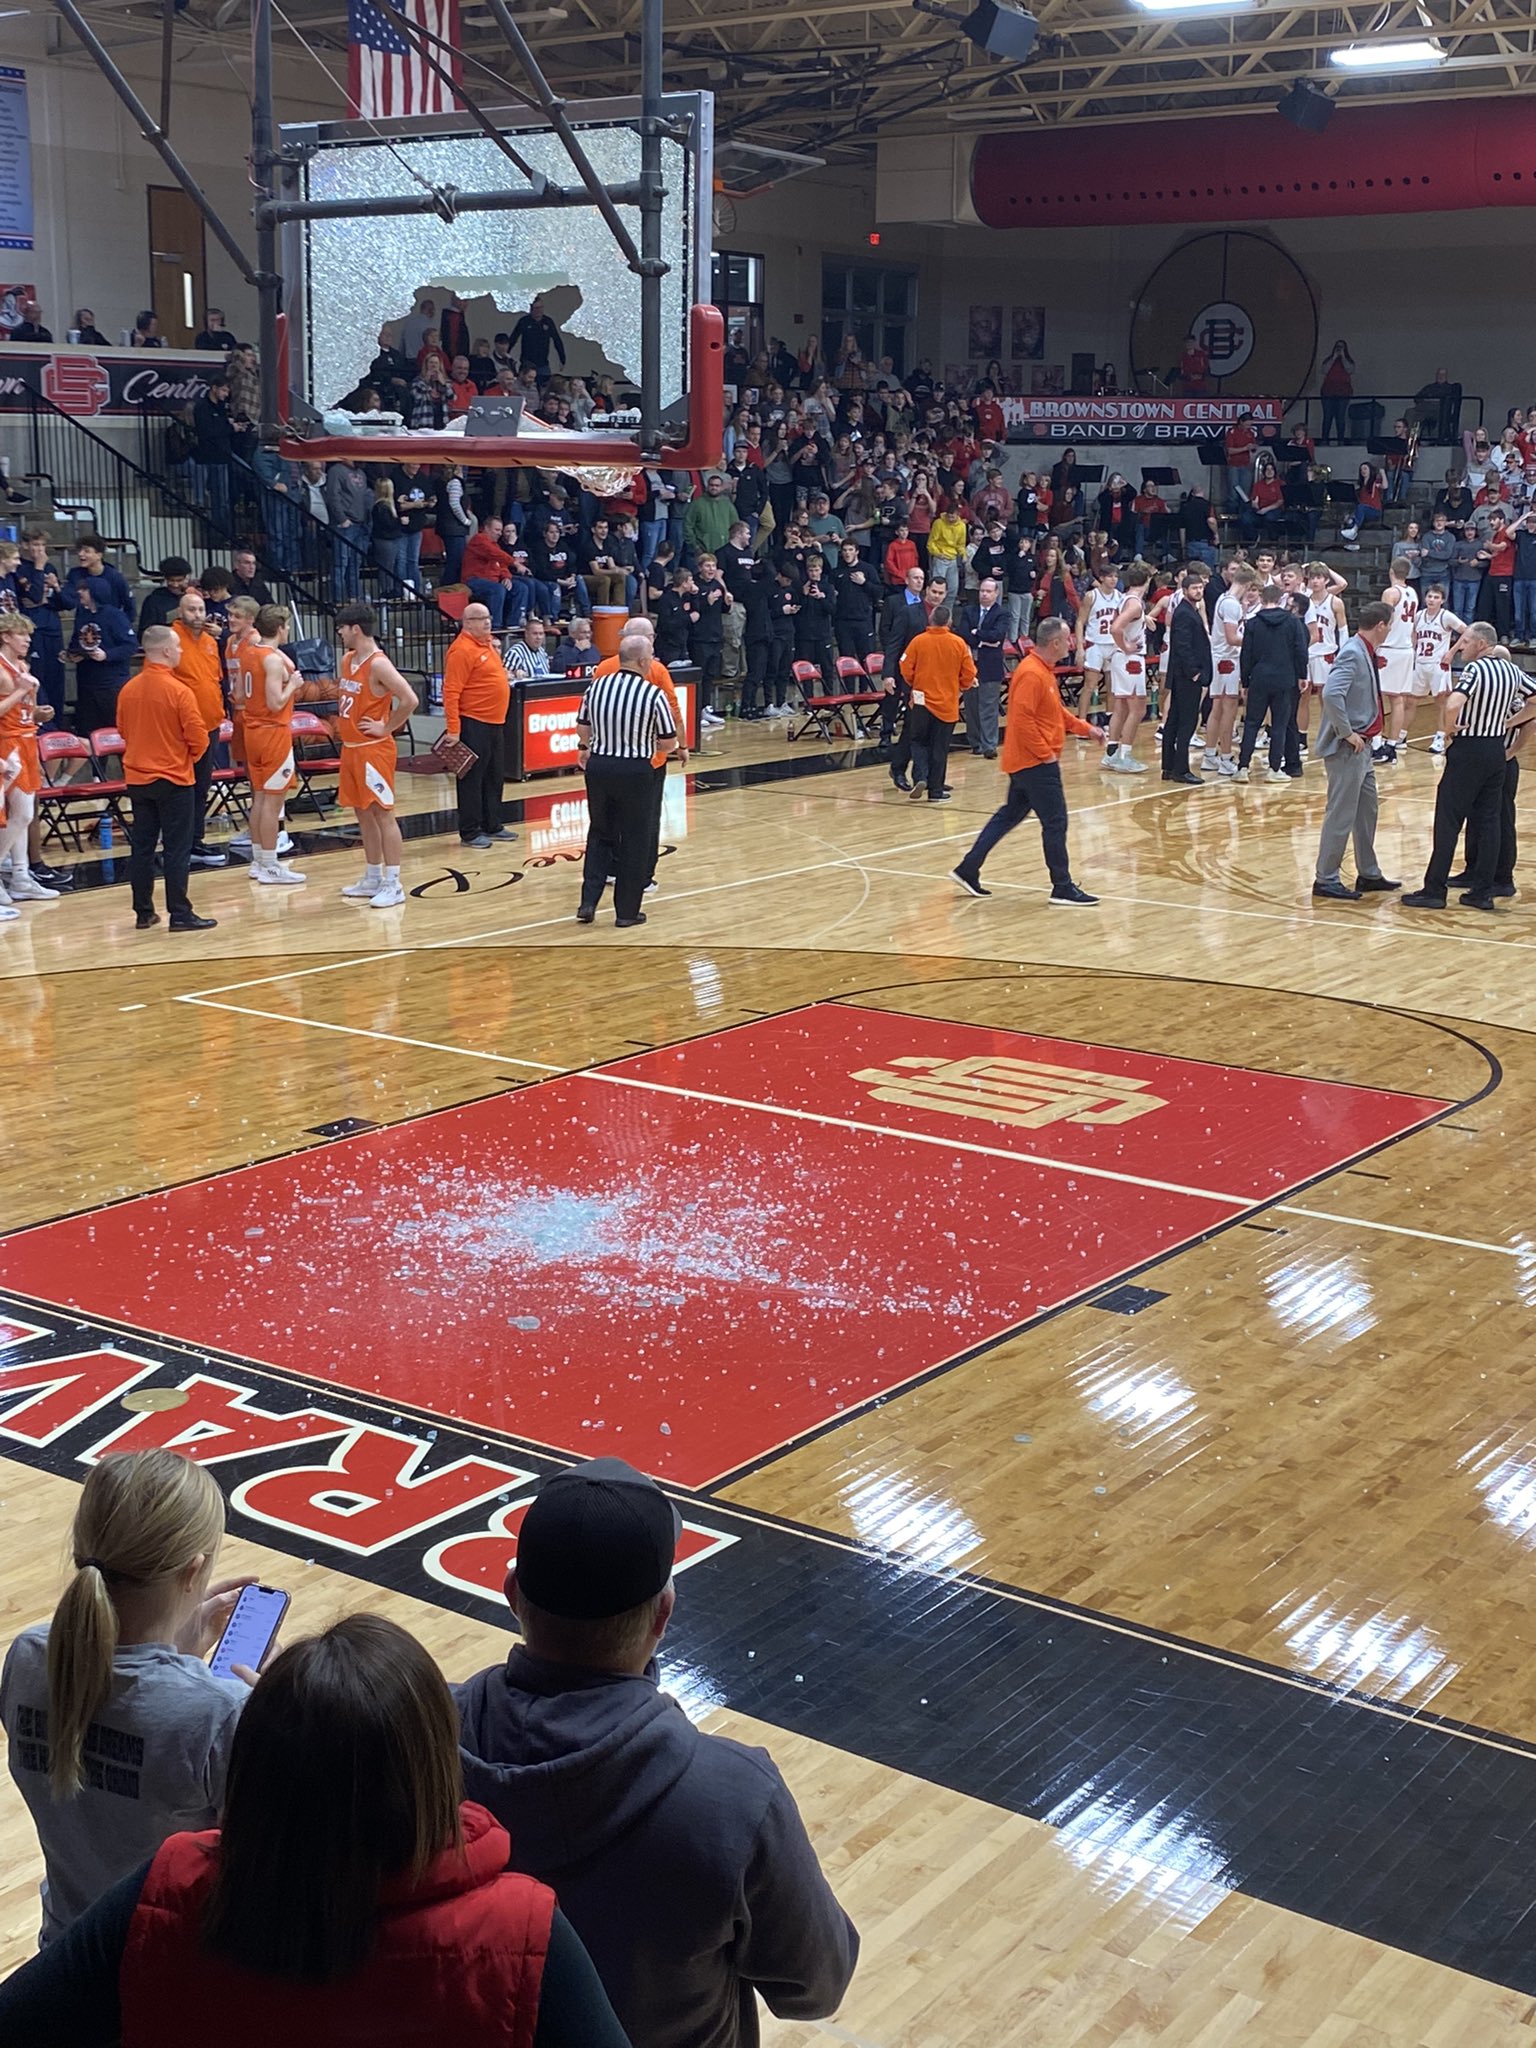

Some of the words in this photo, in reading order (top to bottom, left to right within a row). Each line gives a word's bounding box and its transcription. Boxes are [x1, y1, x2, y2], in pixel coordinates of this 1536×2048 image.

[123, 370, 212, 404] Centr
[1028, 401, 1175, 420] BROWNSTOWN
[1050, 423, 1127, 438] BAND
[1099, 619, 1114, 635] 2
[1418, 641, 1435, 657] 12
